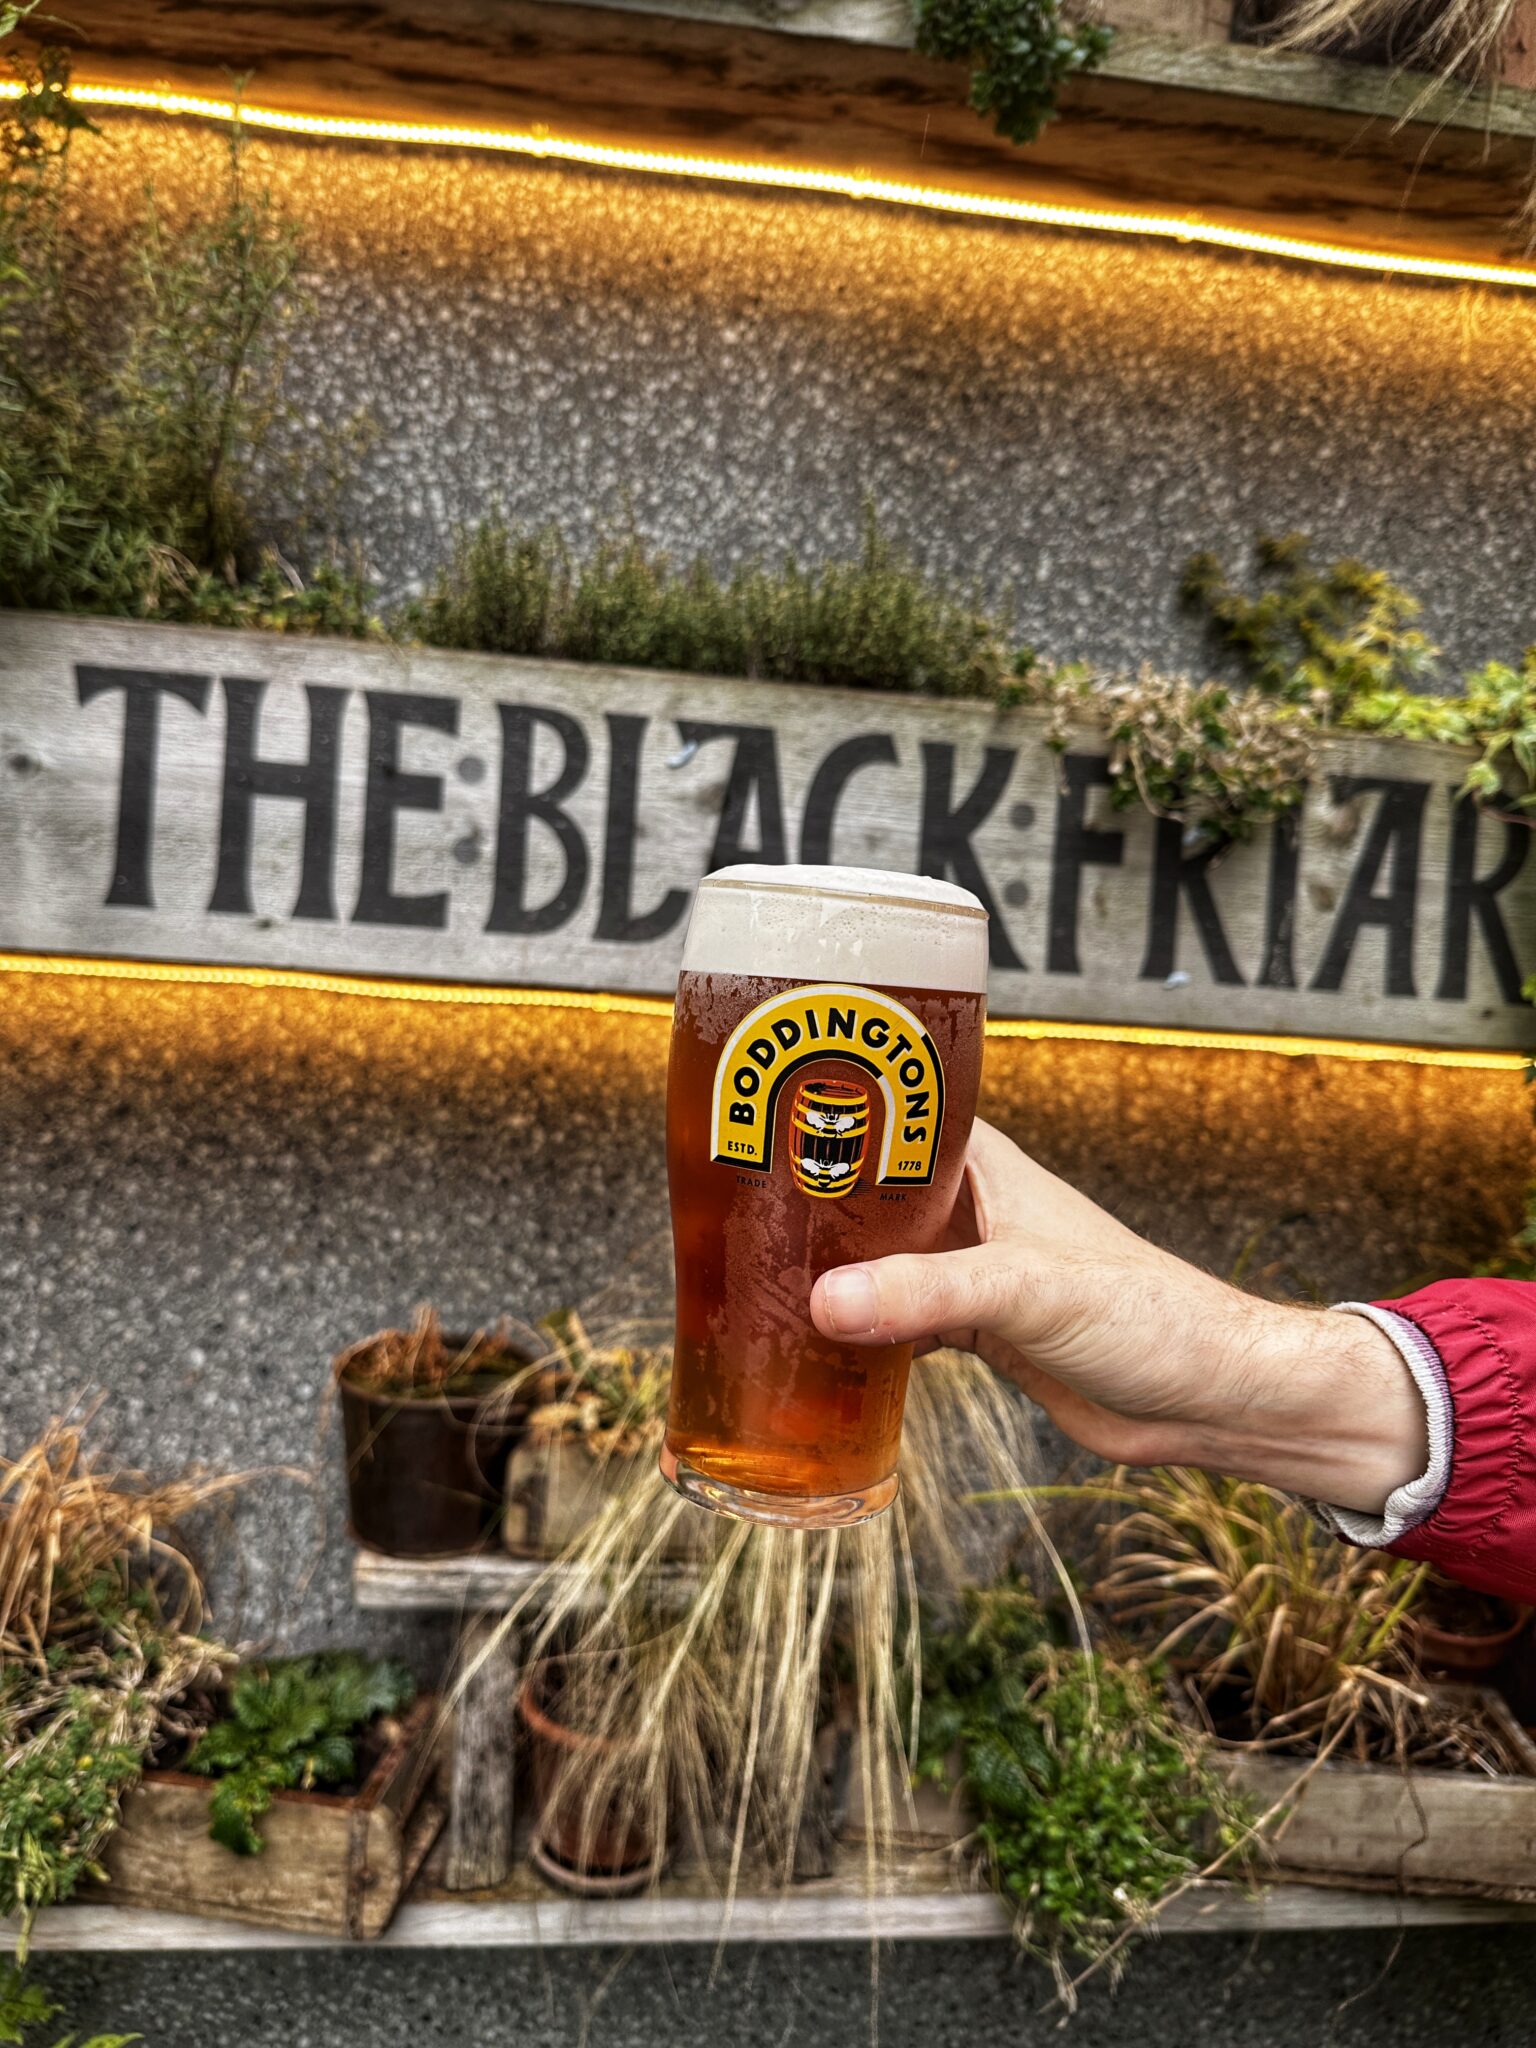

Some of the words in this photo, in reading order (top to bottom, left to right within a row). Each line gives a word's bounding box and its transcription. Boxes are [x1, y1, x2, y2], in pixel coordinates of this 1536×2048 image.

[75, 663, 461, 929] THE
[728, 1007, 931, 1145] BODDINGTONS
[727, 1140, 758, 1156] ESTD.
[897, 1160, 922, 1171] 1778
[736, 1175, 767, 1189] TRADE
[880, 1192, 907, 1201] MARK
